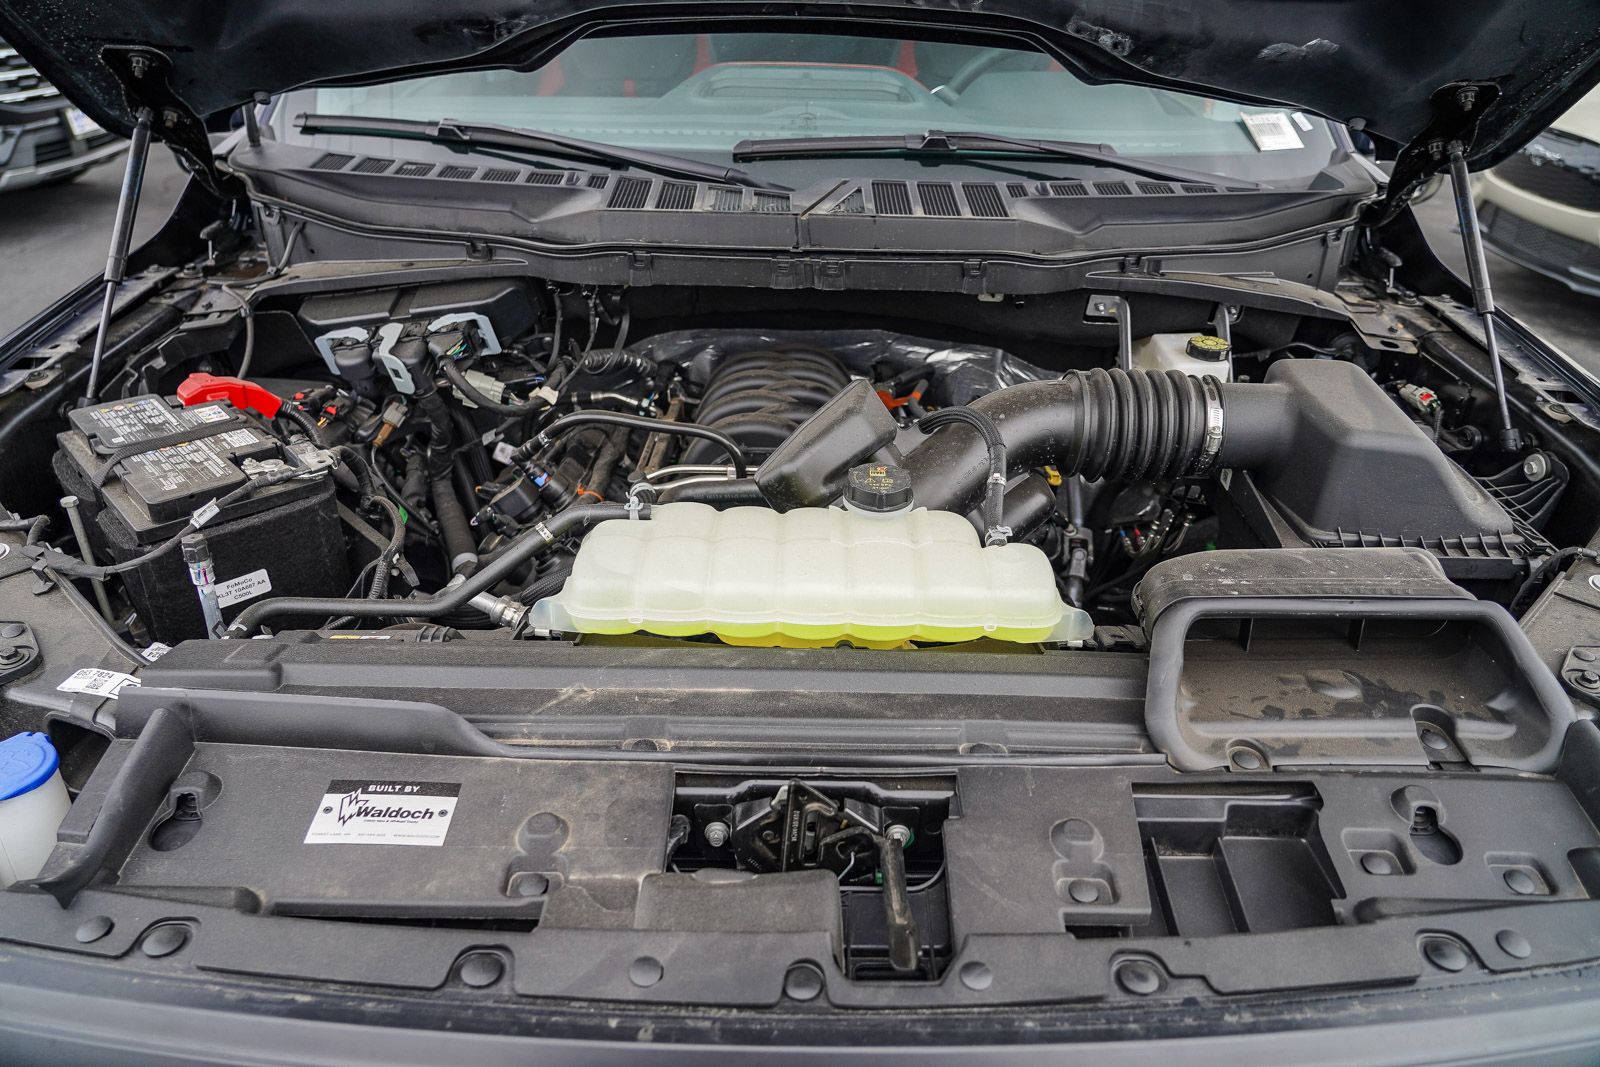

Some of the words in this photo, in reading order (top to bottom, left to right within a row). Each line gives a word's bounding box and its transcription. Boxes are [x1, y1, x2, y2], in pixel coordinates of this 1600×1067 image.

[226, 578, 253, 589] FoMoCo
[367, 784, 402, 793] BUILT
[403, 785, 421, 793] BY
[355, 806, 435, 820] Waldoch
